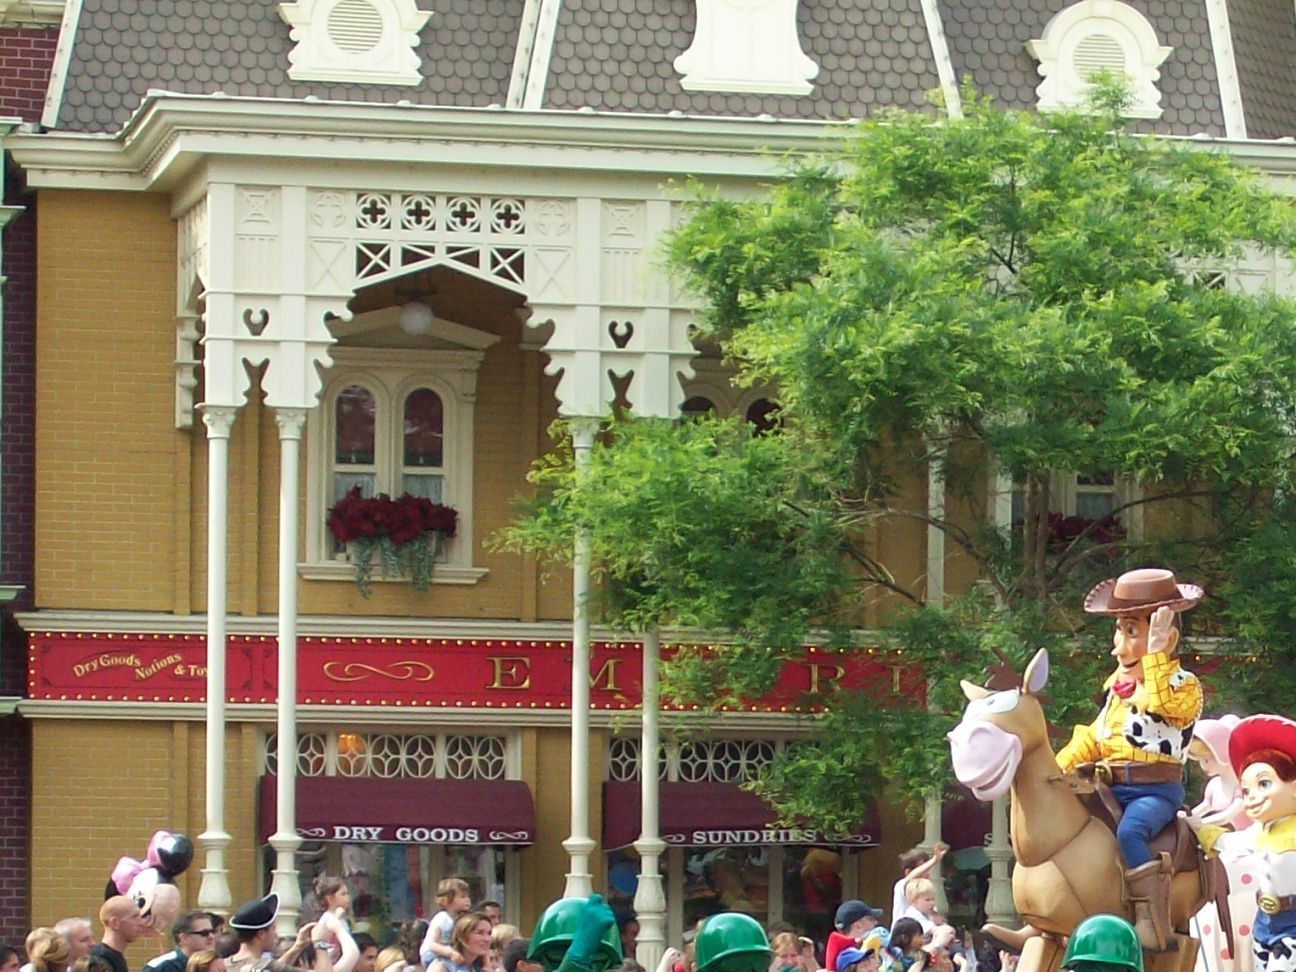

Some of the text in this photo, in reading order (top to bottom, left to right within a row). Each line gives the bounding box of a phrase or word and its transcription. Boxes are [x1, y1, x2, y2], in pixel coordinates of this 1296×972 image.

[73, 654, 141, 677] Dry Goods
[135, 653, 182, 679] Notions
[174, 665, 185, 675] &
[333, 826, 479, 842] DRY GOODS
[692, 829, 817, 845] SUNDRIES
